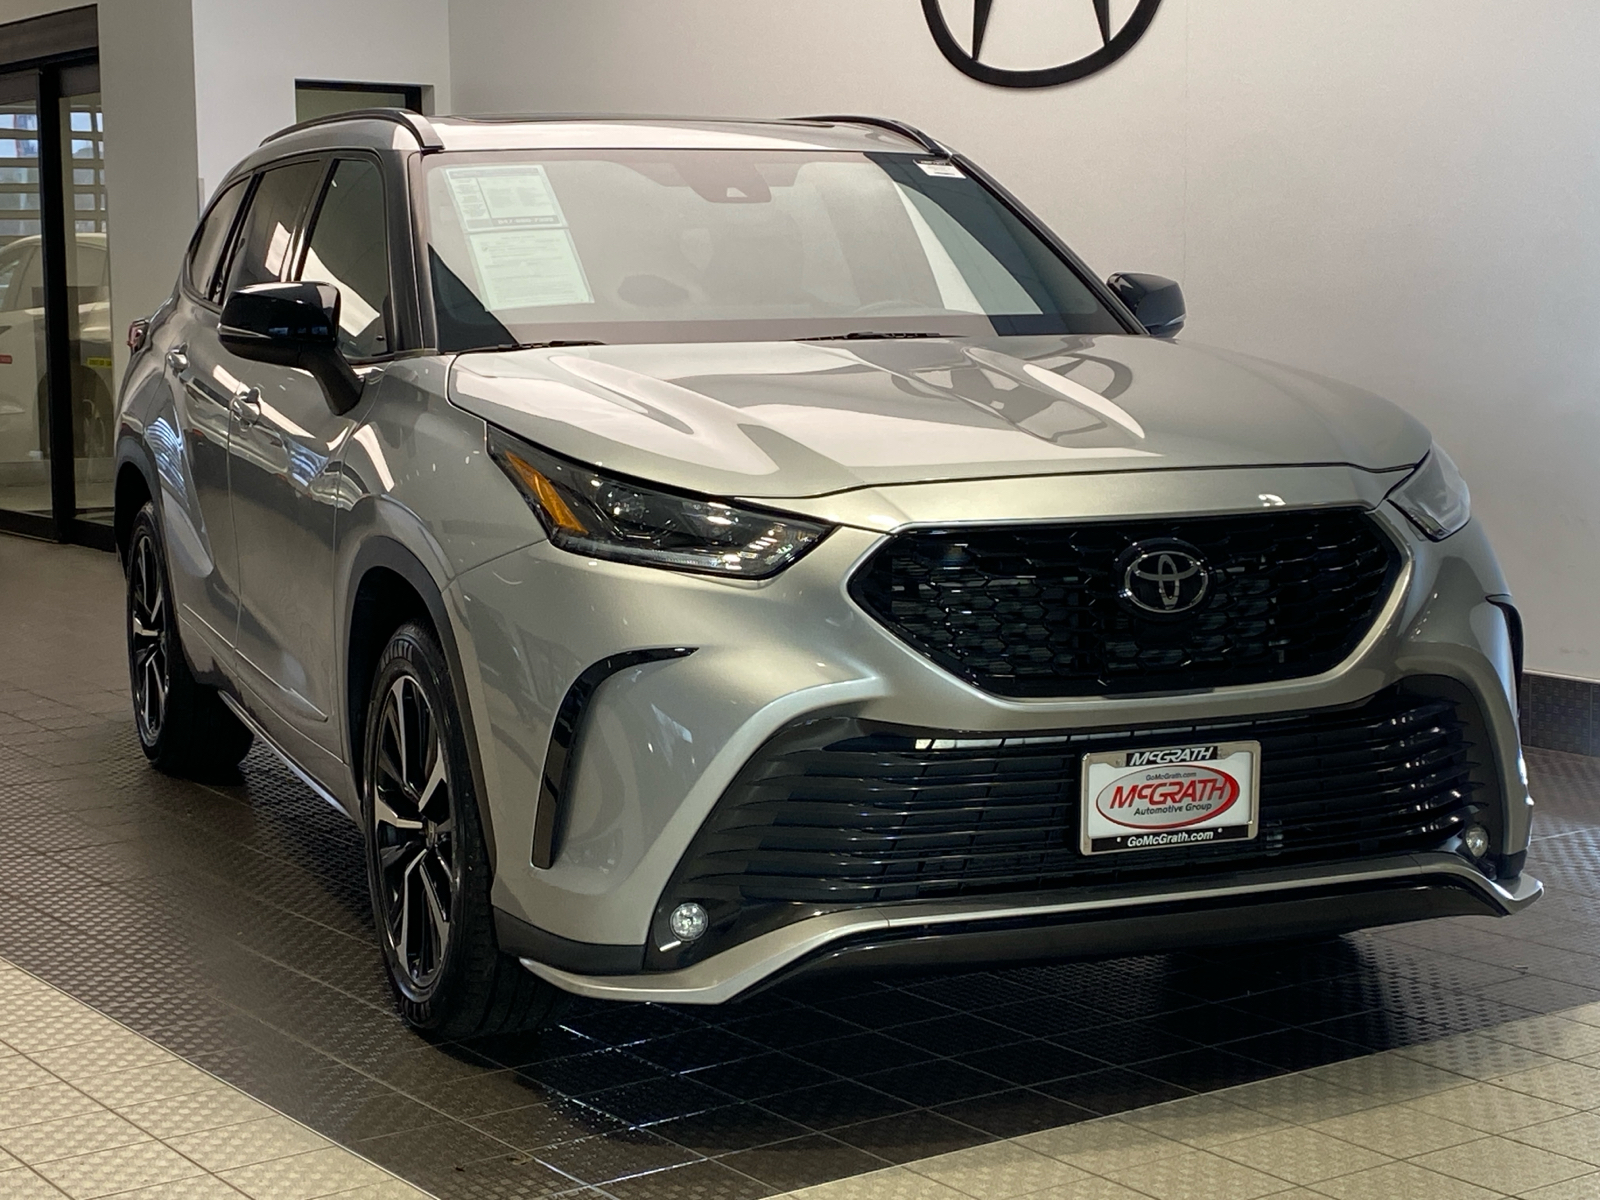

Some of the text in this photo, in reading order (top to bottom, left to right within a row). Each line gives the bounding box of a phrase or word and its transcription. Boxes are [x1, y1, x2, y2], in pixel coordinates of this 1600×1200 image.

[1146, 772, 1197, 781] GoMcGrath.com
[1133, 803, 1212, 816] Automotive Group
[1127, 831, 1214, 847] GoMcGrath.com
